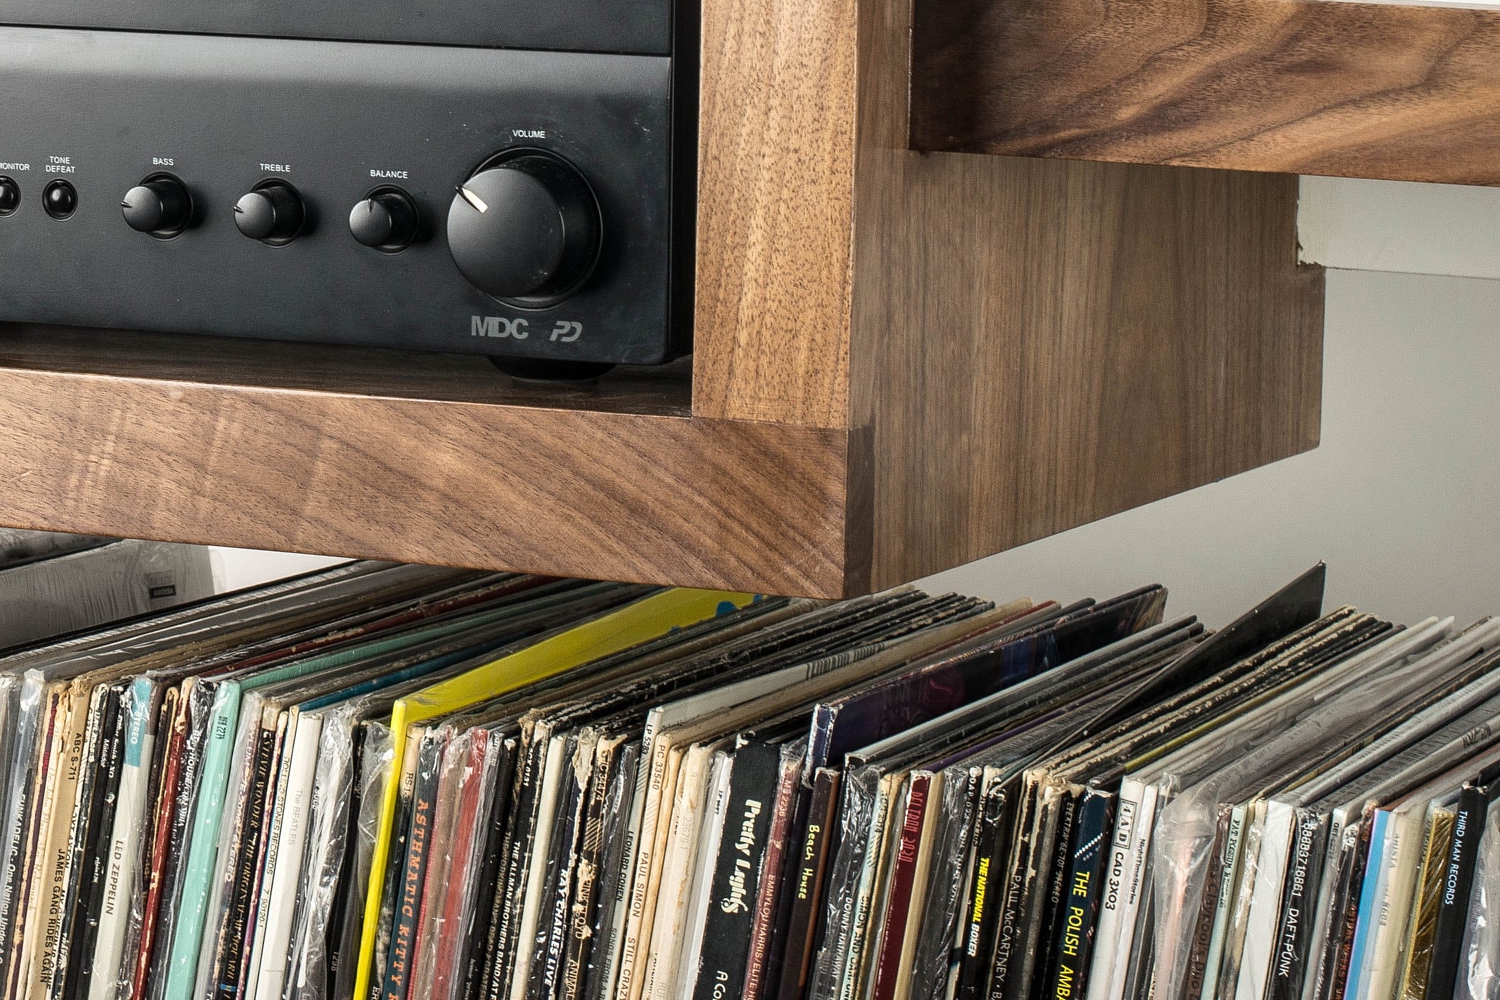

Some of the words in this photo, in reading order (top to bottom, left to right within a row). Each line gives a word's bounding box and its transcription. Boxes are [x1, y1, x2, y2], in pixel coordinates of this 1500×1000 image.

[512, 129, 546, 139] VOLUME
[45, 165, 76, 174] DEFEAT
[49, 156, 71, 165] TONE
[153, 158, 174, 167] BASS
[260, 163, 291, 173] TREBLE
[370, 169, 408, 179] BALANCE
[471, 316, 529, 340] MDC
[70, 733, 82, 754] ABC
[646, 723, 653, 735] LP
[259, 738, 273, 778] STEVIE
[641, 737, 651, 756] 5283
[659, 744, 666, 758] PC
[67, 755, 79, 781] S-711
[652, 760, 664, 791] 33540
[596, 773, 608, 801] 34474
[251, 780, 269, 827] WONDER
[274, 795, 285, 829] STONES
[778, 794, 790, 817] 2236
[904, 791, 924, 834] DELTRON
[13, 793, 27, 856] FUNKADELIC
[288, 807, 301, 847] BEATLES
[734, 798, 762, 858] Pretty
[1231, 819, 1241, 837] FAT
[1457, 811, 1469, 837] THIRD
[115, 840, 125, 860] LED
[266, 831, 279, 874] RECORDS
[401, 797, 429, 918] ASTHMATIC
[512, 841, 521, 859] THE
[623, 830, 634, 870] LEONARD
[806, 824, 820, 861] Beach
[898, 835, 916, 863] 3030
[1225, 838, 1238, 868] POSSUM
[1453, 841, 1464, 861] MAN
[6, 864, 17, 883] One
[53, 848, 64, 882] JAMES
[506, 861, 518, 898] ALLMAN
[639, 852, 650, 880] PAUL
[978, 857, 990, 875] THE
[1112, 852, 1124, 877] CAD
[1129, 838, 1146, 906] NightTimeStories
[105, 863, 122, 916] ZEPPELIN
[557, 868, 568, 896] RAY
[618, 872, 628, 901] COHEN
[720, 858, 751, 915] Lights
[798, 867, 814, 900] House
[1006, 875, 1022, 908] PAUL
[1073, 871, 1090, 898] THE
[1444, 864, 1460, 906] RECORDS
[2, 885, 14, 914] Nation
[49, 885, 61, 915] GANG
[632, 881, 645, 918] SIMON
[762, 874, 775, 921] EMMYLOU
[972, 875, 987, 922] NATIONAL
[258, 898, 269, 928] 90120-1
[498, 900, 513, 948] BROTHERS
[549, 897, 564, 954] CHARLES
[840, 896, 852, 930] DONNY
[45, 919, 57, 947] RIDES
[608, 927, 618, 956] SONGS
[967, 923, 980, 956] BOXER
[995, 909, 1019, 982] McCARTNEY
[1063, 906, 1084, 957] POLISH
[1277, 908, 1300, 978] DAFT-PUNK
[389, 925, 411, 987] KITTY
[626, 936, 636, 965] STILL
[750, 922, 767, 988] HARRIS/ELITE
[831, 932, 846, 979] HATHAWAY
[40, 951, 53, 983] AGAIN
[544, 957, 557, 986] LIVE
[604, 958, 613, 982] FROM
[717, 970, 729, 982] A
[621, 968, 632, 1000] CRAZ
